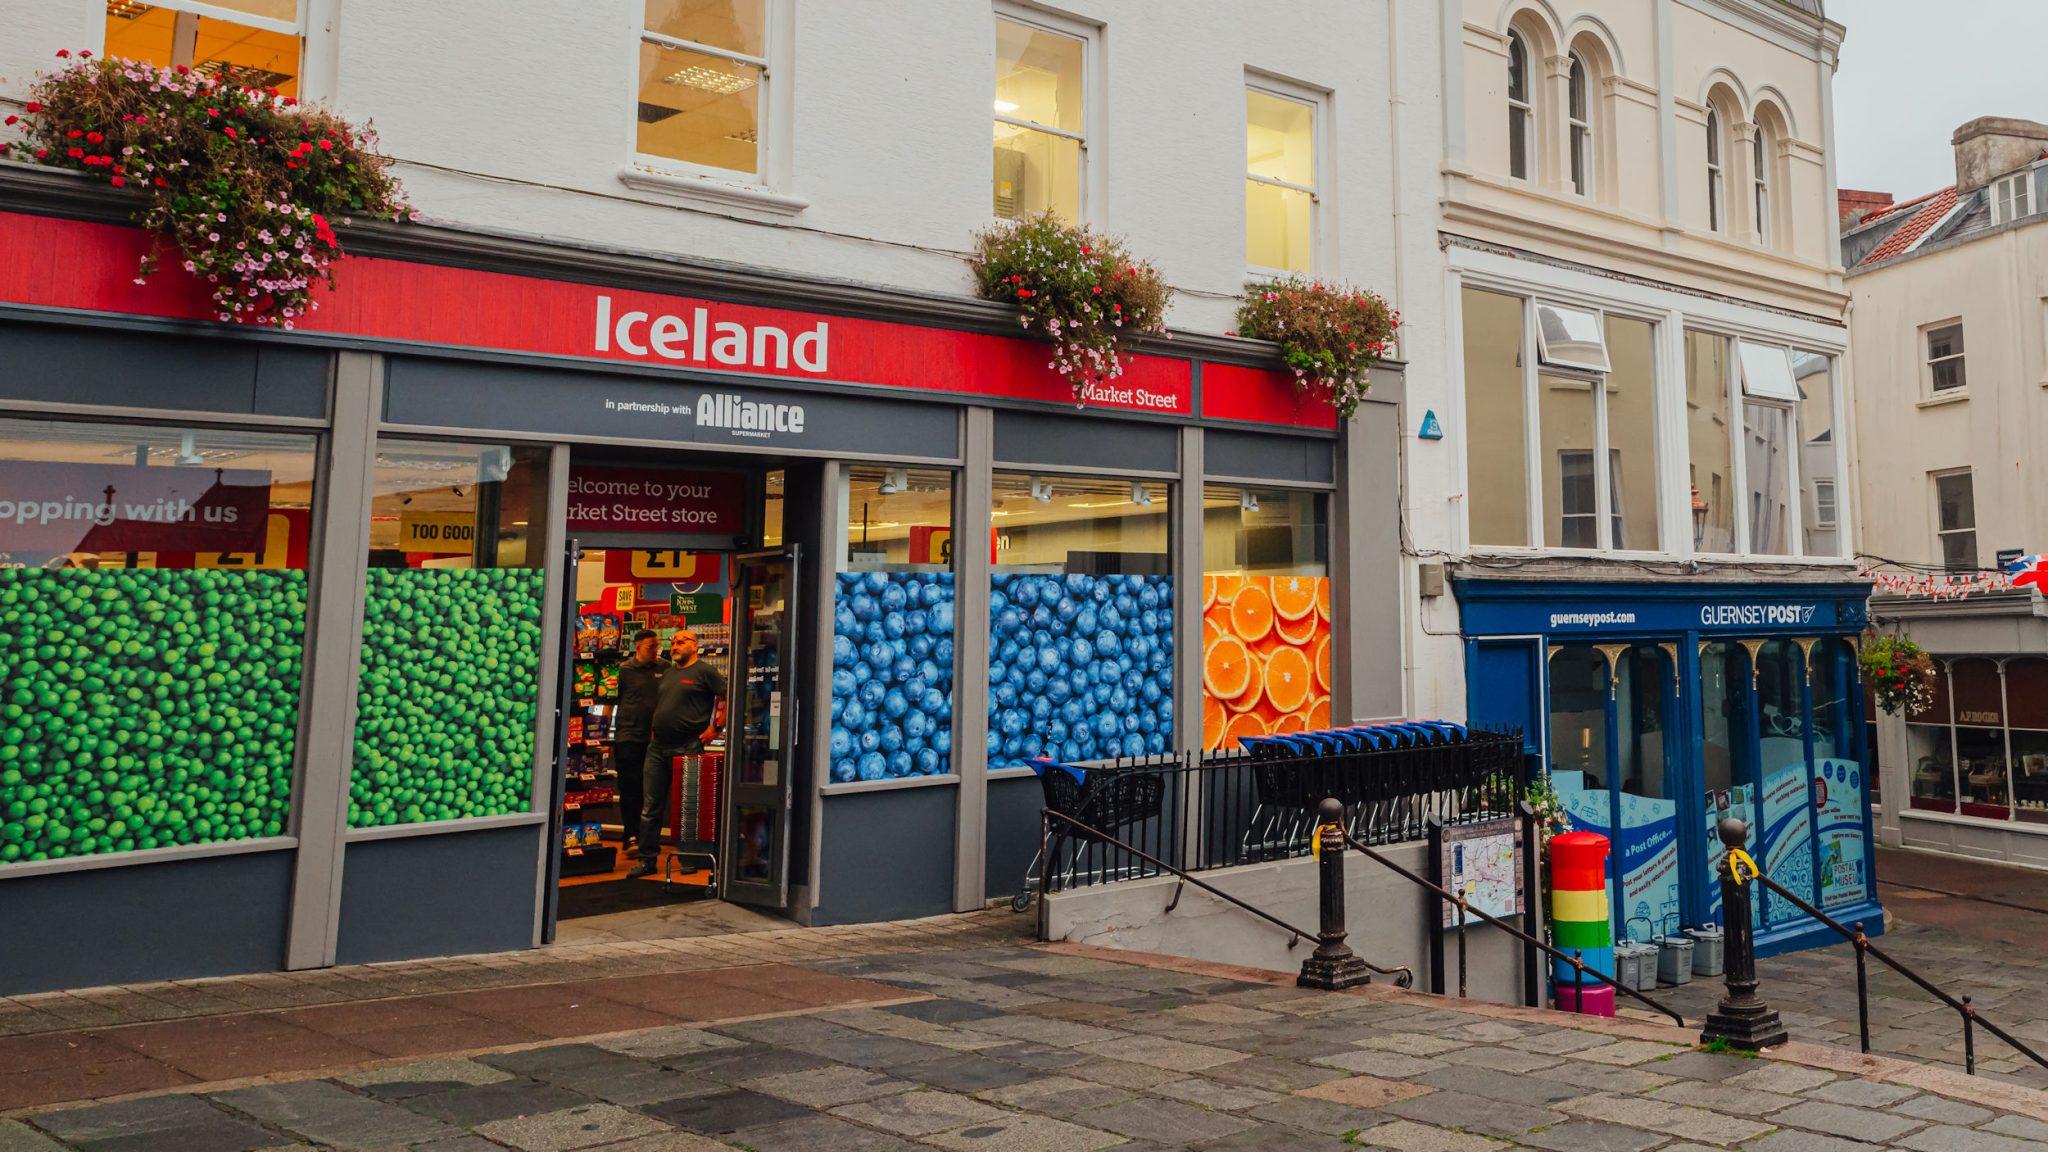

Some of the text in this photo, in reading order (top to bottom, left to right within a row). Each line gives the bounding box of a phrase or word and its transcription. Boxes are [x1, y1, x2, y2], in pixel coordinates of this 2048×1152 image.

[595, 295, 828, 372] Iceland
[1081, 384, 1177, 408] Market Street
[605, 399, 692, 416] in partnership with
[696, 393, 805, 433] Alliance
[731, 430, 771, 438] SUPERMARKET
[568, 477, 712, 501] elcome to your
[0, 496, 239, 525] opping with us
[566, 503, 718, 523] rket Street store
[412, 524, 438, 539] TOO
[1550, 611, 1635, 627] guernseypost.com
[1631, 841, 1647, 855] Post
[1833, 861, 1855, 873] POSTAL
